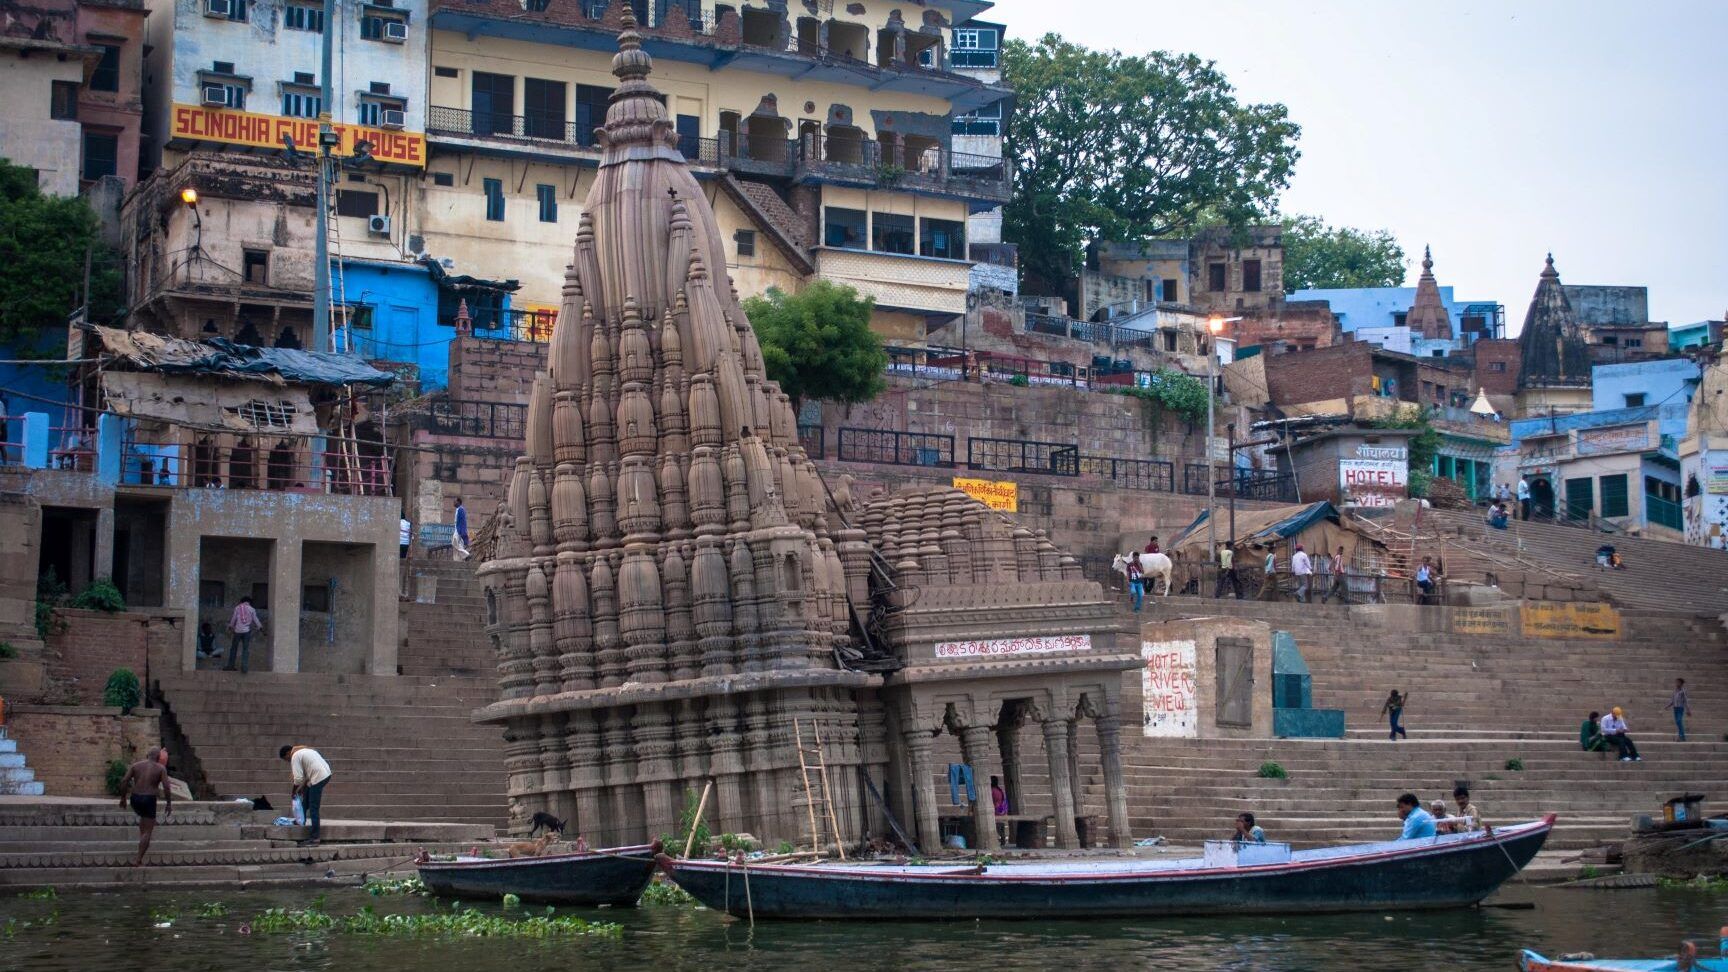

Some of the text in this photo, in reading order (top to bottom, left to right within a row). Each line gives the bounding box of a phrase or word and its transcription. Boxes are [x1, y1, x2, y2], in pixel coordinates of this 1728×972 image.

[176, 108, 270, 143] SCINDHIA
[276, 120, 345, 151] GUET
[1346, 470, 1401, 485] HOTEL
[1146, 652, 1189, 670] HOTEL
[1150, 672, 1194, 690] RIVER
[1153, 694, 1185, 711] VIEW
